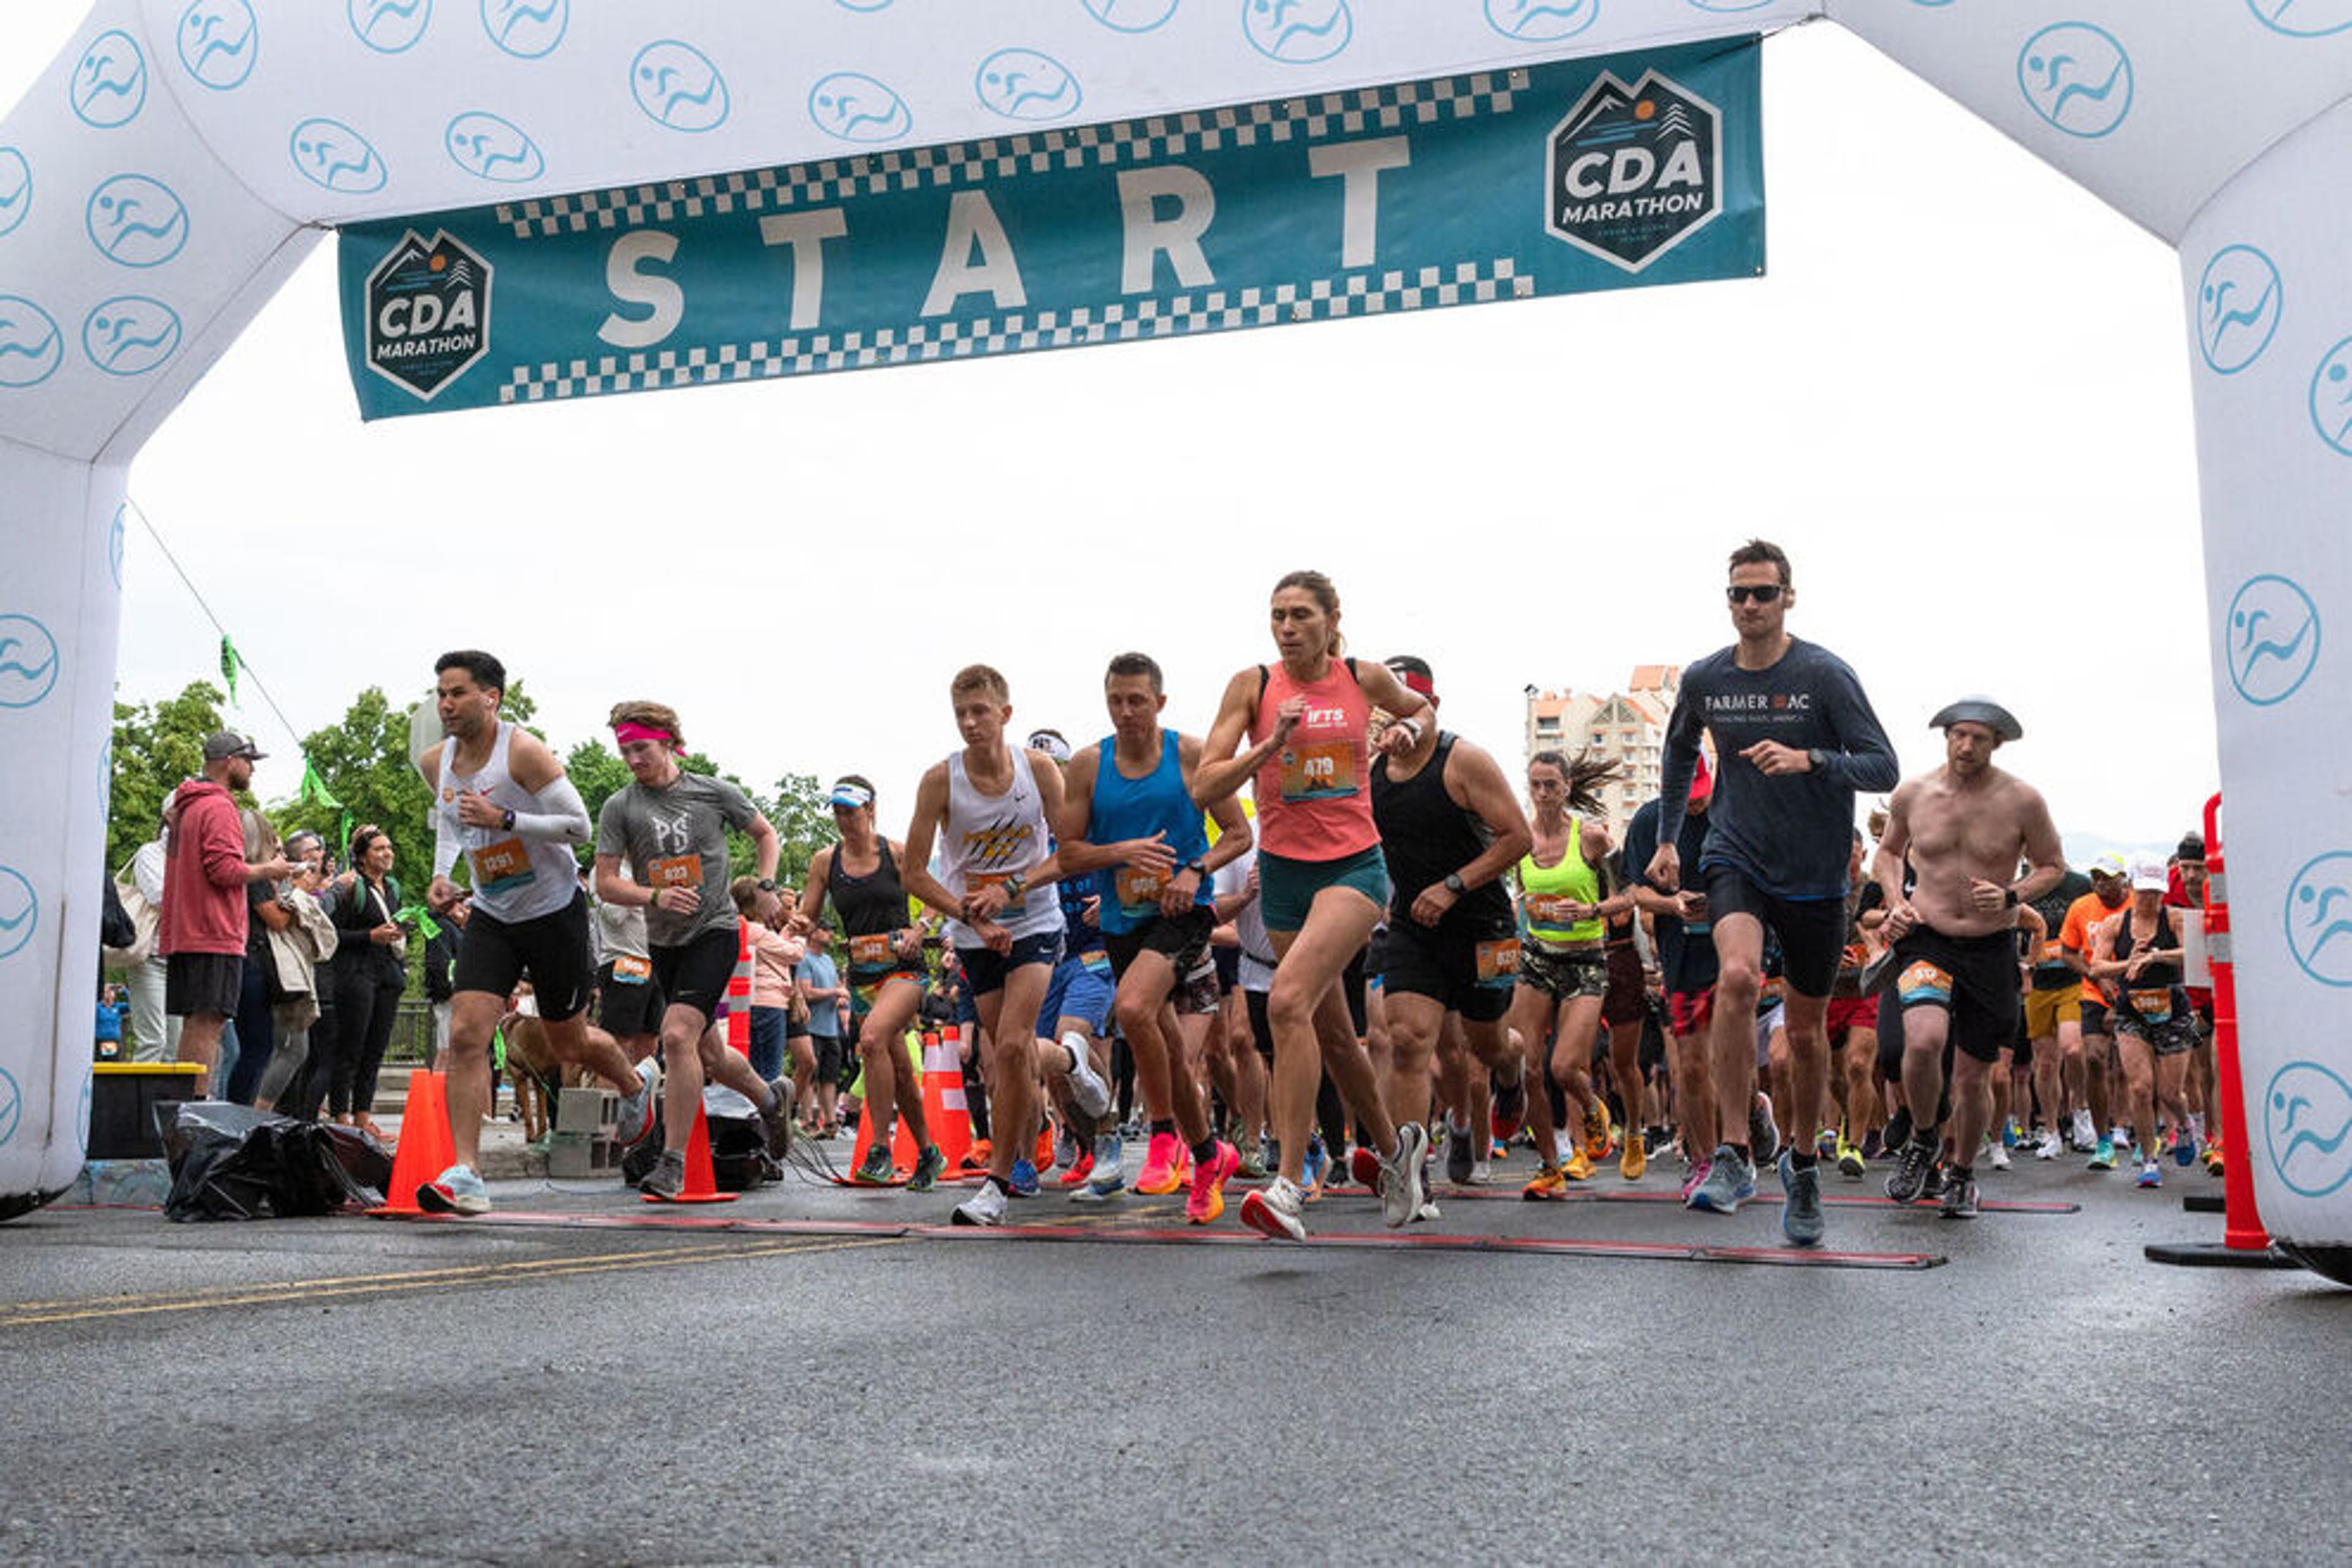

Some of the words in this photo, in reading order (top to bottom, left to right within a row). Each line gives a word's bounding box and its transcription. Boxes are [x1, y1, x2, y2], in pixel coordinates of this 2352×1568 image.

[1564, 140, 1704, 199] CDA
[1562, 192, 1703, 224] MARATHON
[597, 135, 1411, 348] START
[379, 289, 476, 338] CDA
[376, 334, 476, 360] MARATHON
[1705, 693, 1768, 710] FARMER
